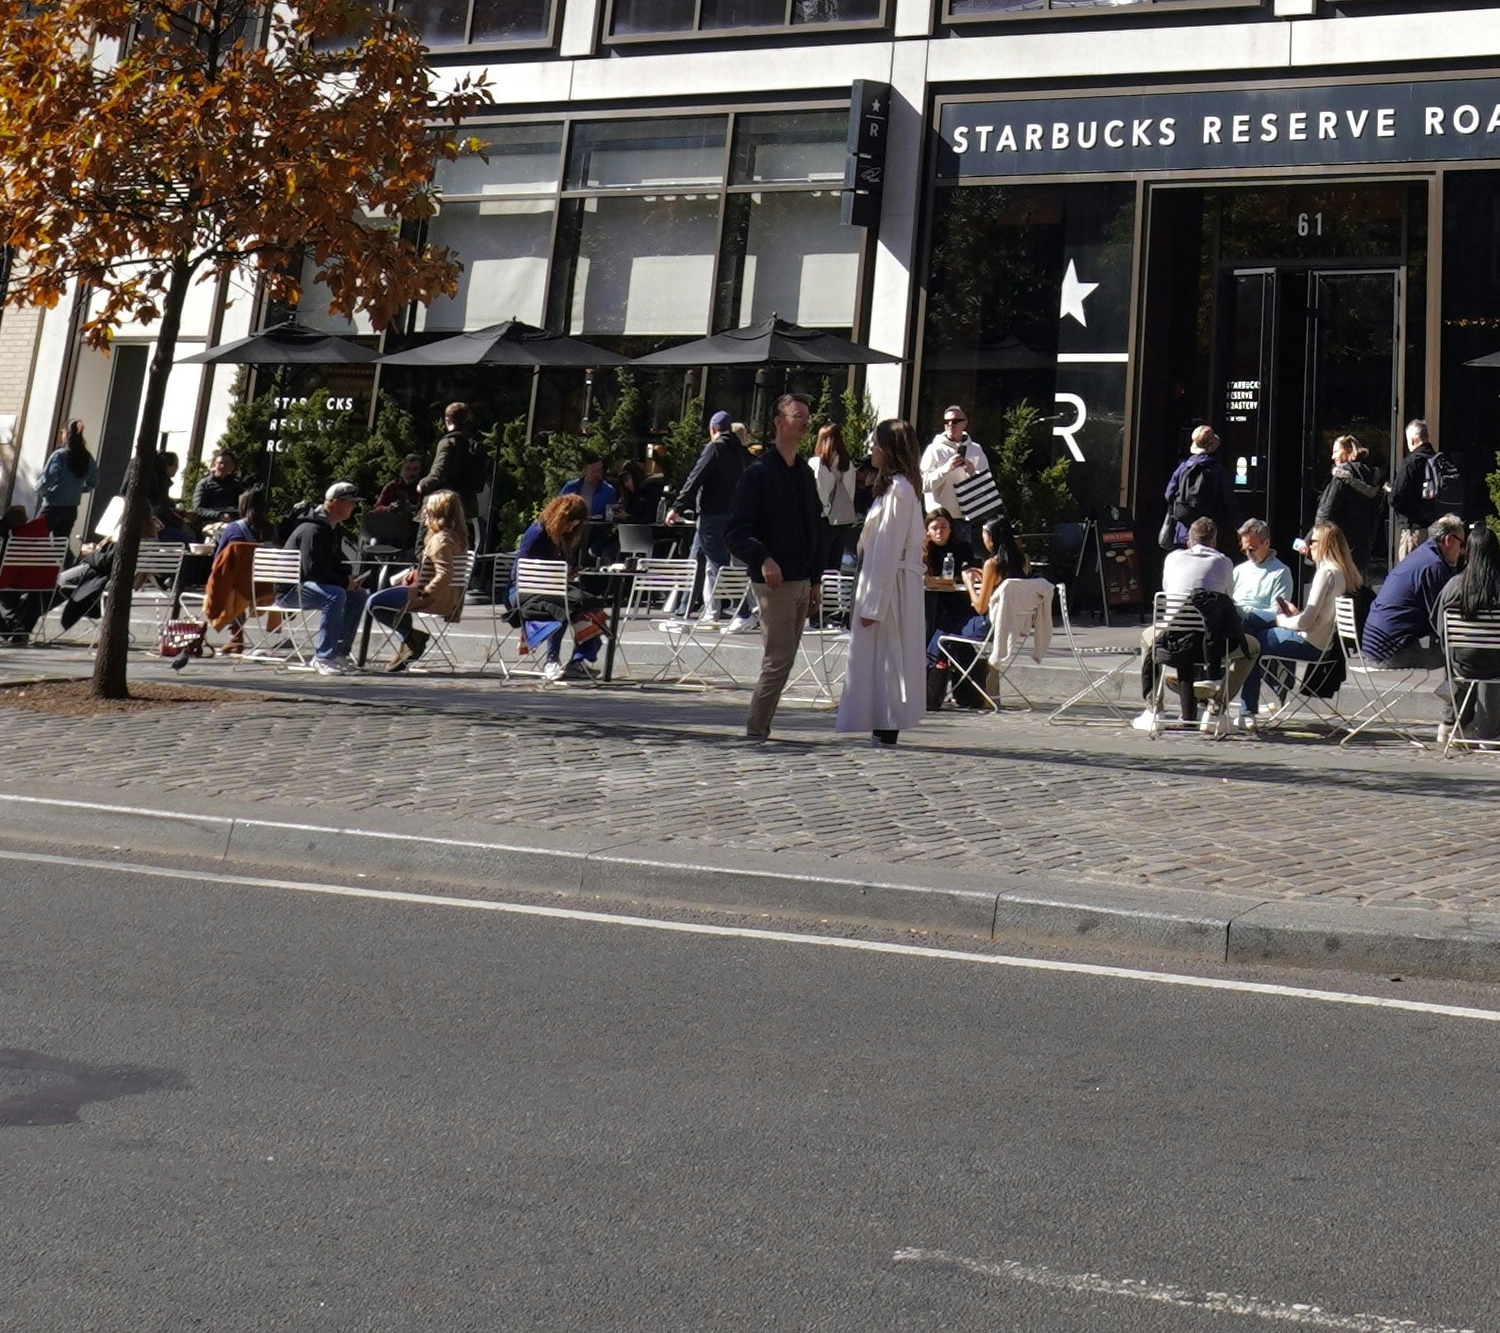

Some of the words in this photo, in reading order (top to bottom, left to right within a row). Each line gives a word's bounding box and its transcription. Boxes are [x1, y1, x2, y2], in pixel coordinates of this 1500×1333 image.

[869, 123, 878, 137] R
[952, 117, 1177, 154] STARBUCKS
[1203, 108, 1396, 144] RESERVE
[1297, 212, 1322, 236] 61
